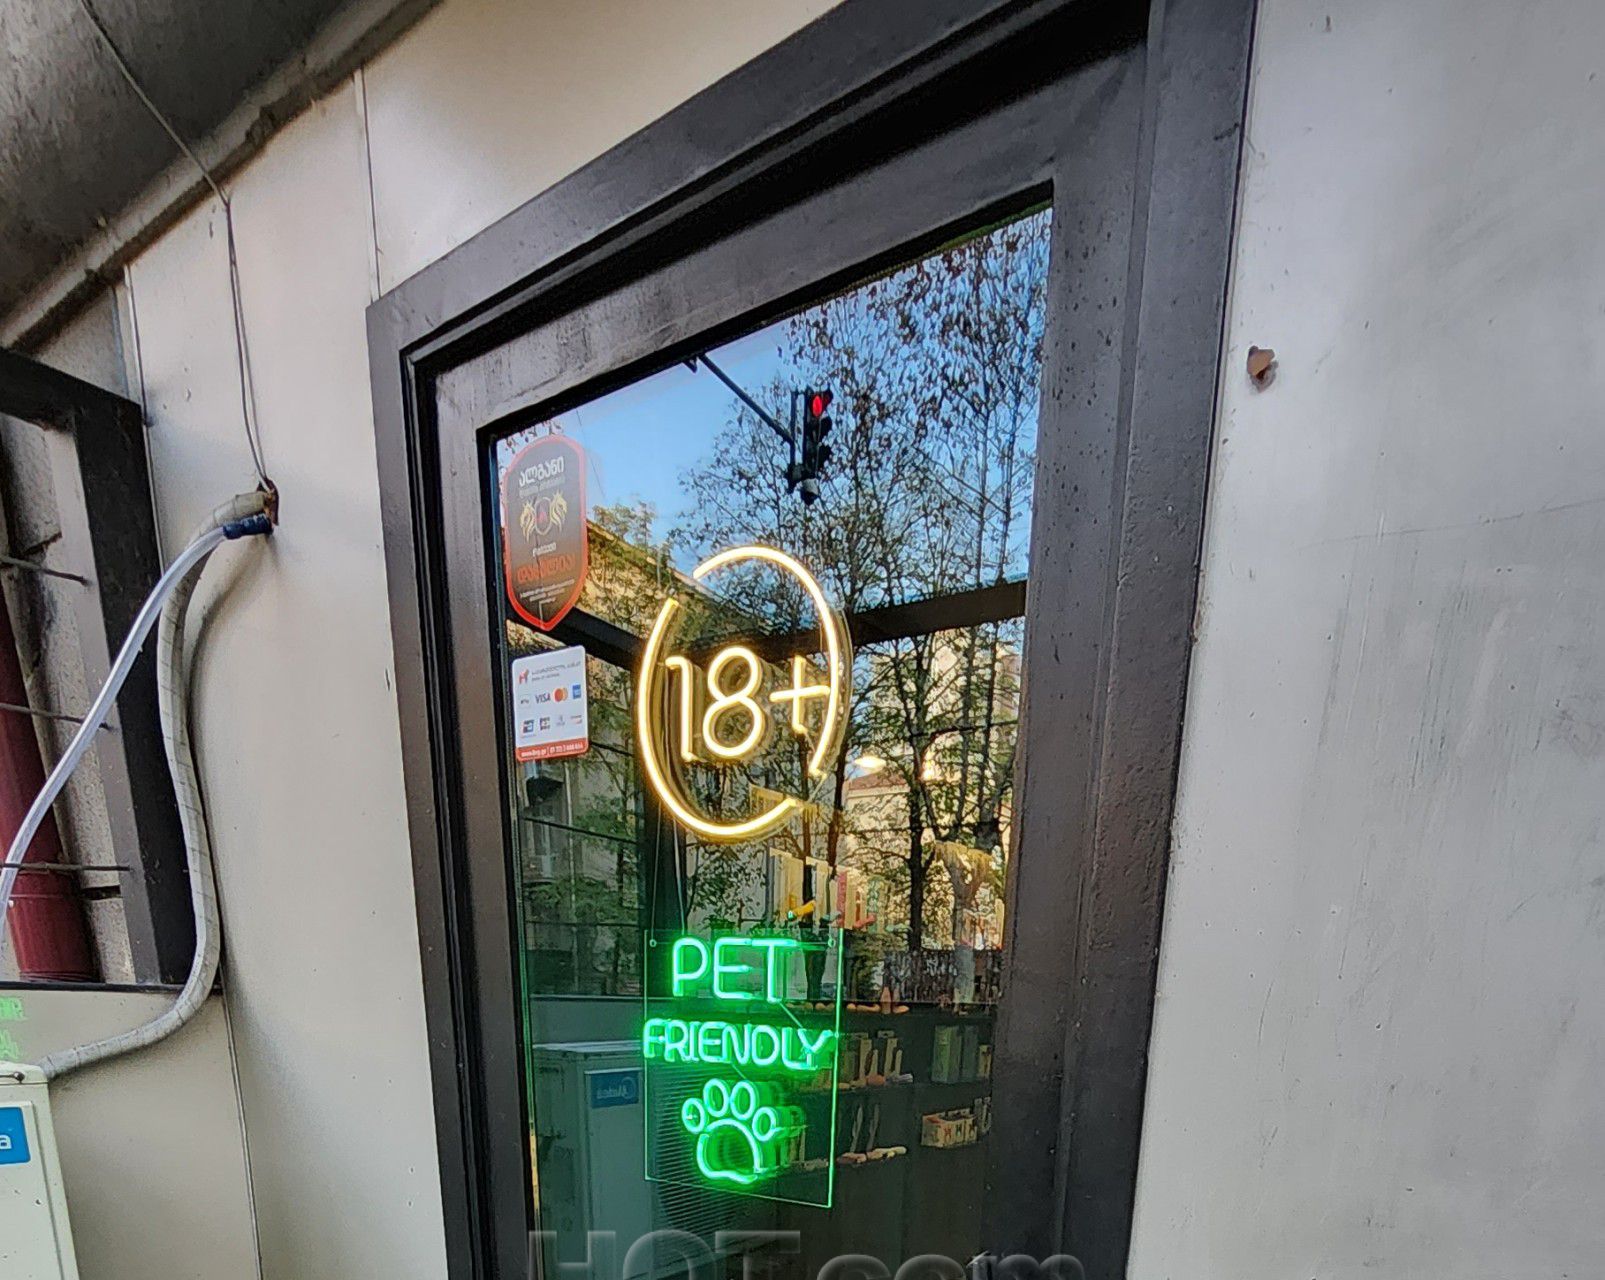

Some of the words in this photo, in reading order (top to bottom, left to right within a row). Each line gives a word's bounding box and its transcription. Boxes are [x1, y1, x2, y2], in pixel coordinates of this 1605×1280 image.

[534, 692, 551, 704] VISA
[665, 646, 831, 763] 18+
[672, 937, 797, 1003] PET
[643, 1018, 834, 1070] FRIENDLY
